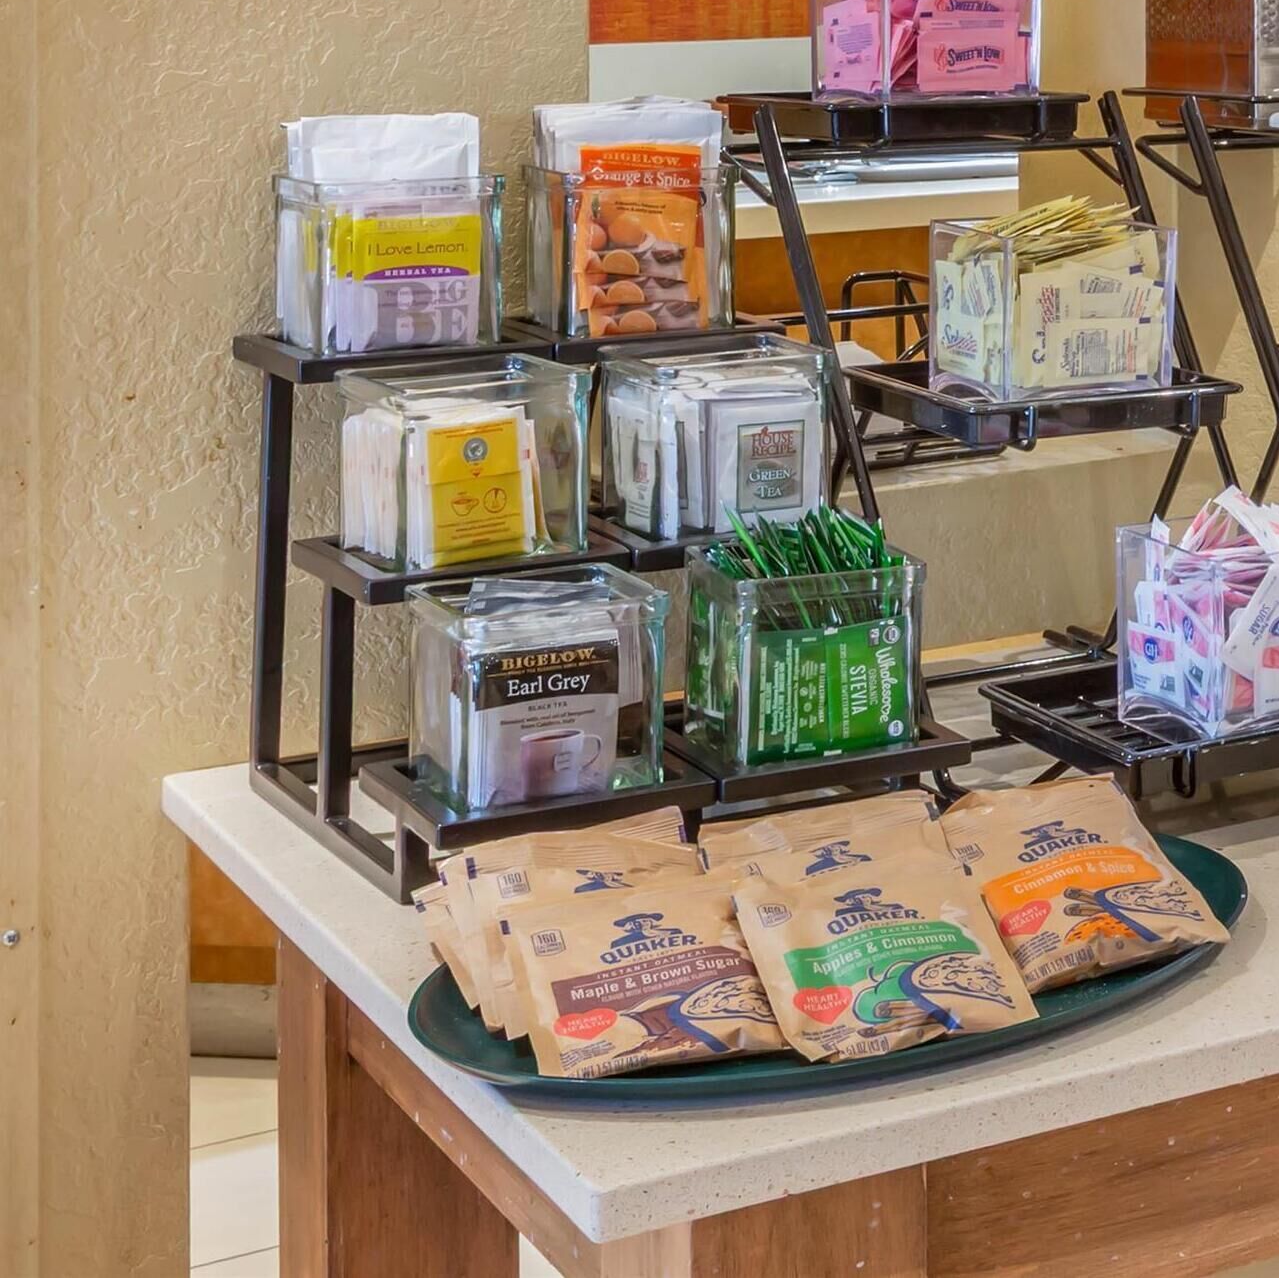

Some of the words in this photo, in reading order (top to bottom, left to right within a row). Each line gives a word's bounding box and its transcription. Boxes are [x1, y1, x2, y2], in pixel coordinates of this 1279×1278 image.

[643, 173, 654, 184] &
[656, 171, 690, 190] Spice
[376, 243, 412, 256] Love
[752, 430, 793, 446] HOUSE
[752, 444, 796, 457] RECIPE
[749, 468, 792, 482] GREEN
[759, 485, 782, 499] TEA
[501, 647, 596, 671] BIGELOW
[507, 677, 543, 697] Earl
[548, 674, 590, 694] Grey
[849, 664, 868, 715] STEVIA
[868, 668, 878, 706] ORGANIC
[875, 647, 898, 723] Wholesome
[1018, 833, 1104, 863] QUAKER
[1013, 864, 1083, 894] Cinnamon
[1086, 862, 1097, 873] &
[1100, 861, 1136, 875] Spice
[827, 909, 922, 935] QUAKER
[1008, 905, 1040, 925] HEART
[1008, 909, 1047, 934] HEALTHY
[537, 933, 556, 944] 160
[880, 925, 930, 934] OATMEAL
[600, 935, 701, 964] QUAKER
[812, 949, 861, 975] Apples
[866, 942, 878, 954] &
[882, 933, 957, 949] Cinnamon
[597, 963, 648, 980] INSTANT
[655, 949, 707, 966] OATMEAL
[571, 981, 619, 1002] Maple
[624, 977, 637, 990] &
[641, 963, 692, 985] Brown
[696, 956, 741, 972] Sugar
[803, 997, 850, 1012] HEALTHY
[806, 992, 839, 1003] HEART
[563, 1020, 611, 1034] HEALTHY
[568, 1014, 604, 1026] HEART
